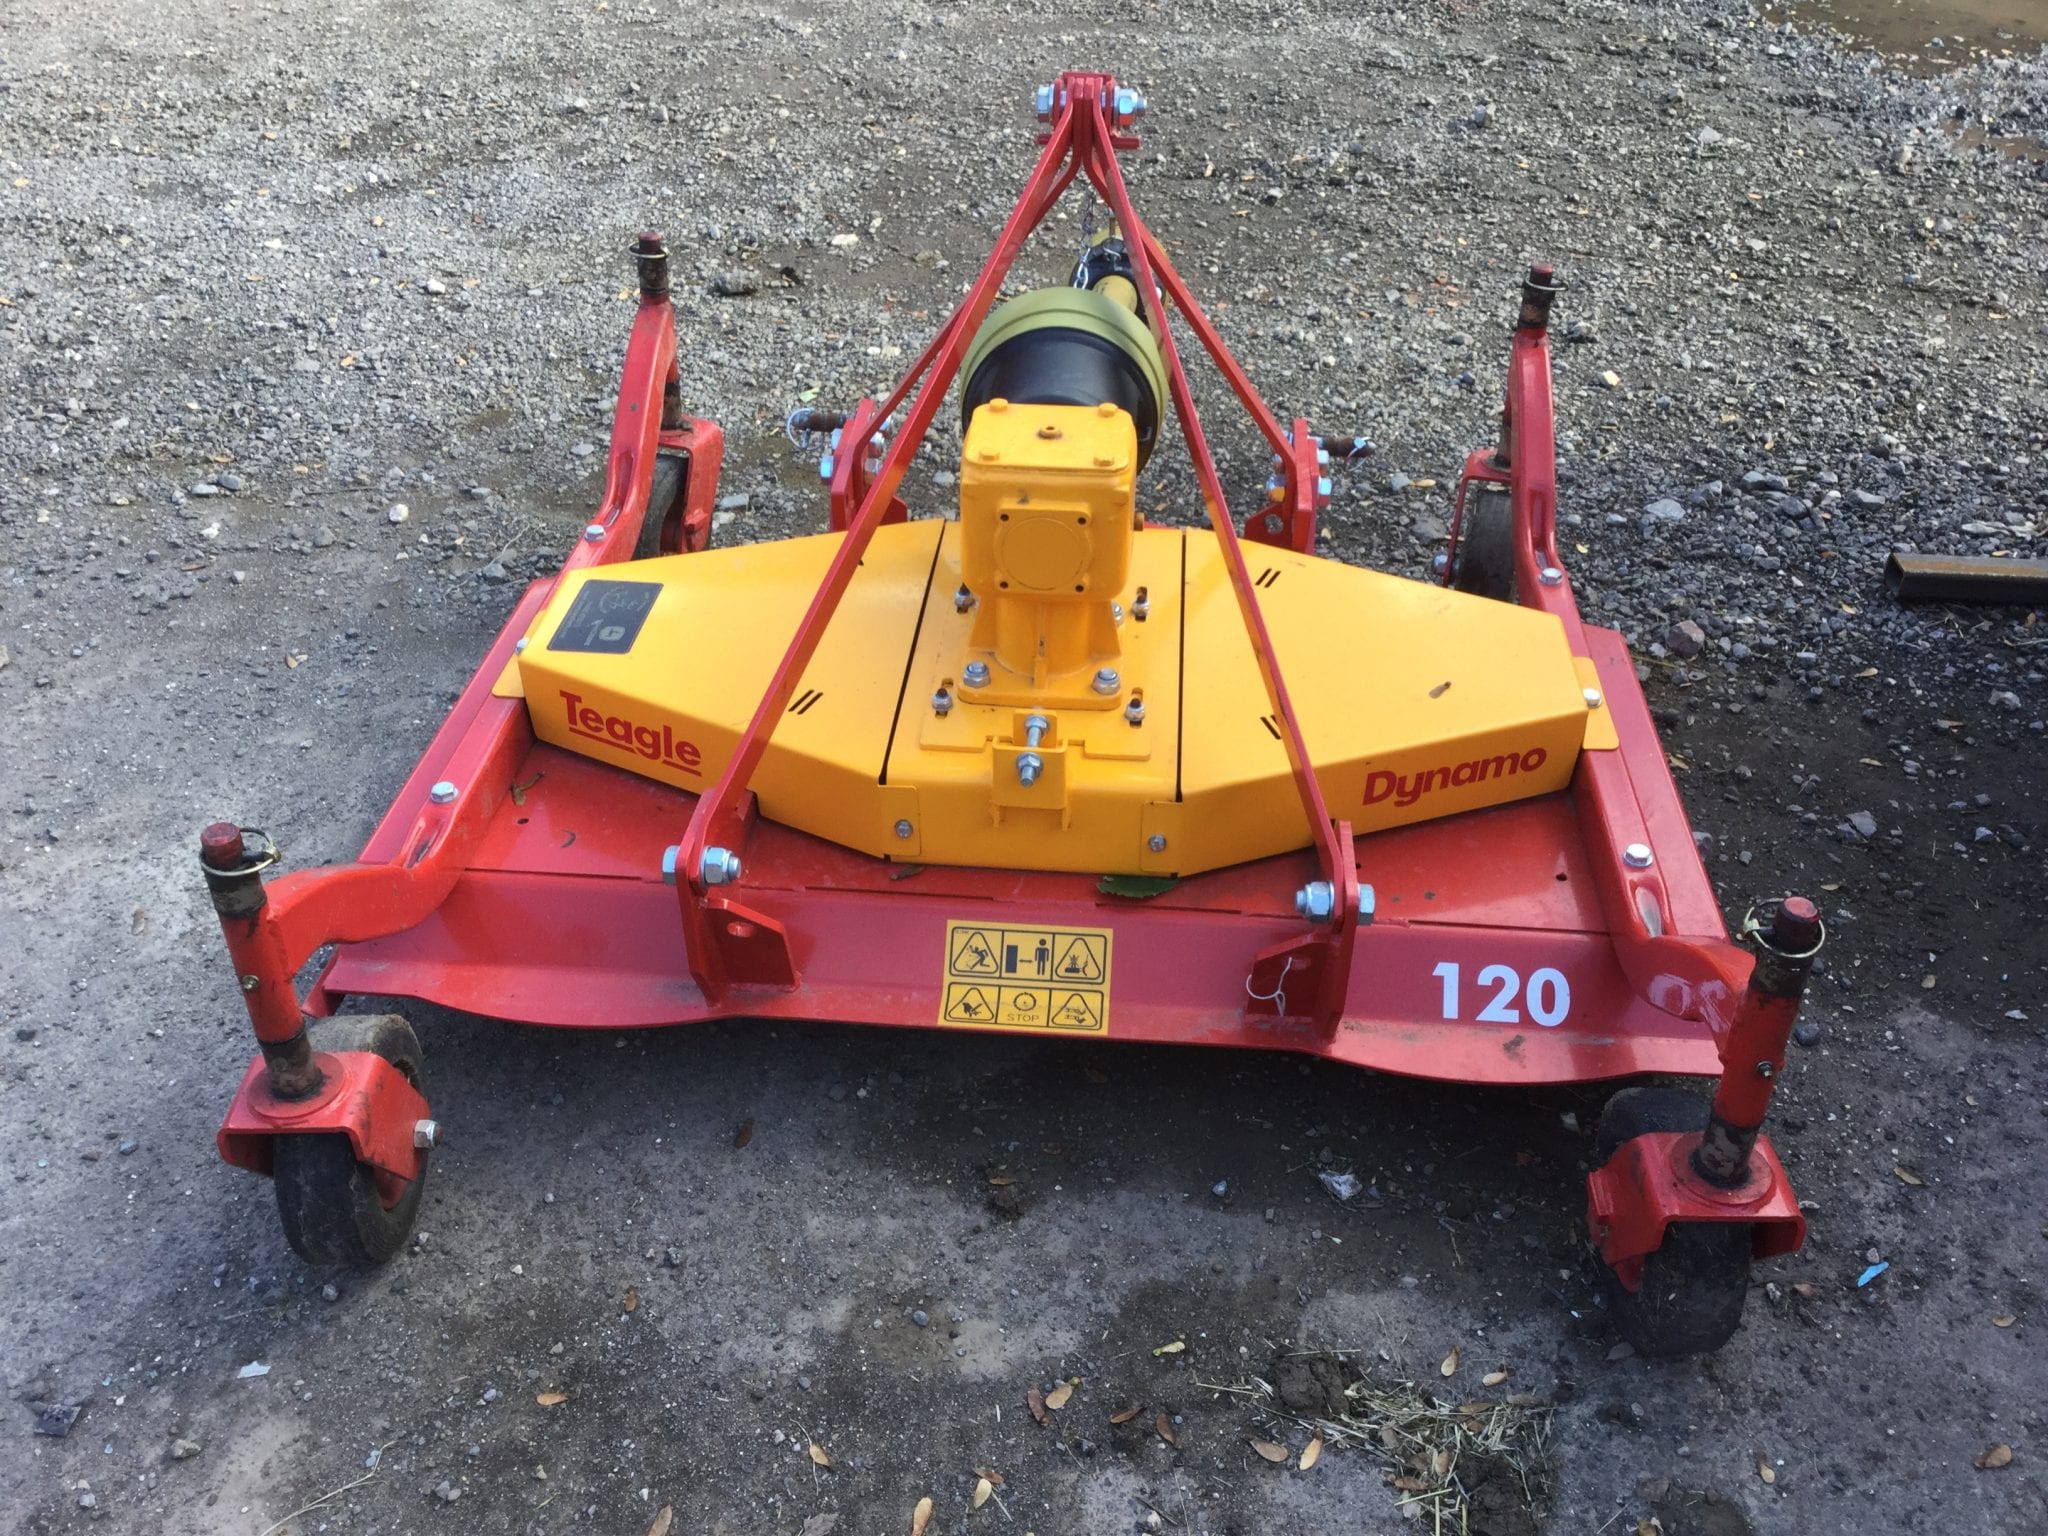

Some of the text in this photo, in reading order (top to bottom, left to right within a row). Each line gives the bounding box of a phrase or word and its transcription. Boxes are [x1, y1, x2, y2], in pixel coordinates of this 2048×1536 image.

[559, 690, 702, 766] Teagle
[1362, 747, 1547, 807] Dynamo
[1007, 1013, 1040, 1022] STOP
[1432, 962, 1570, 1027] 120
